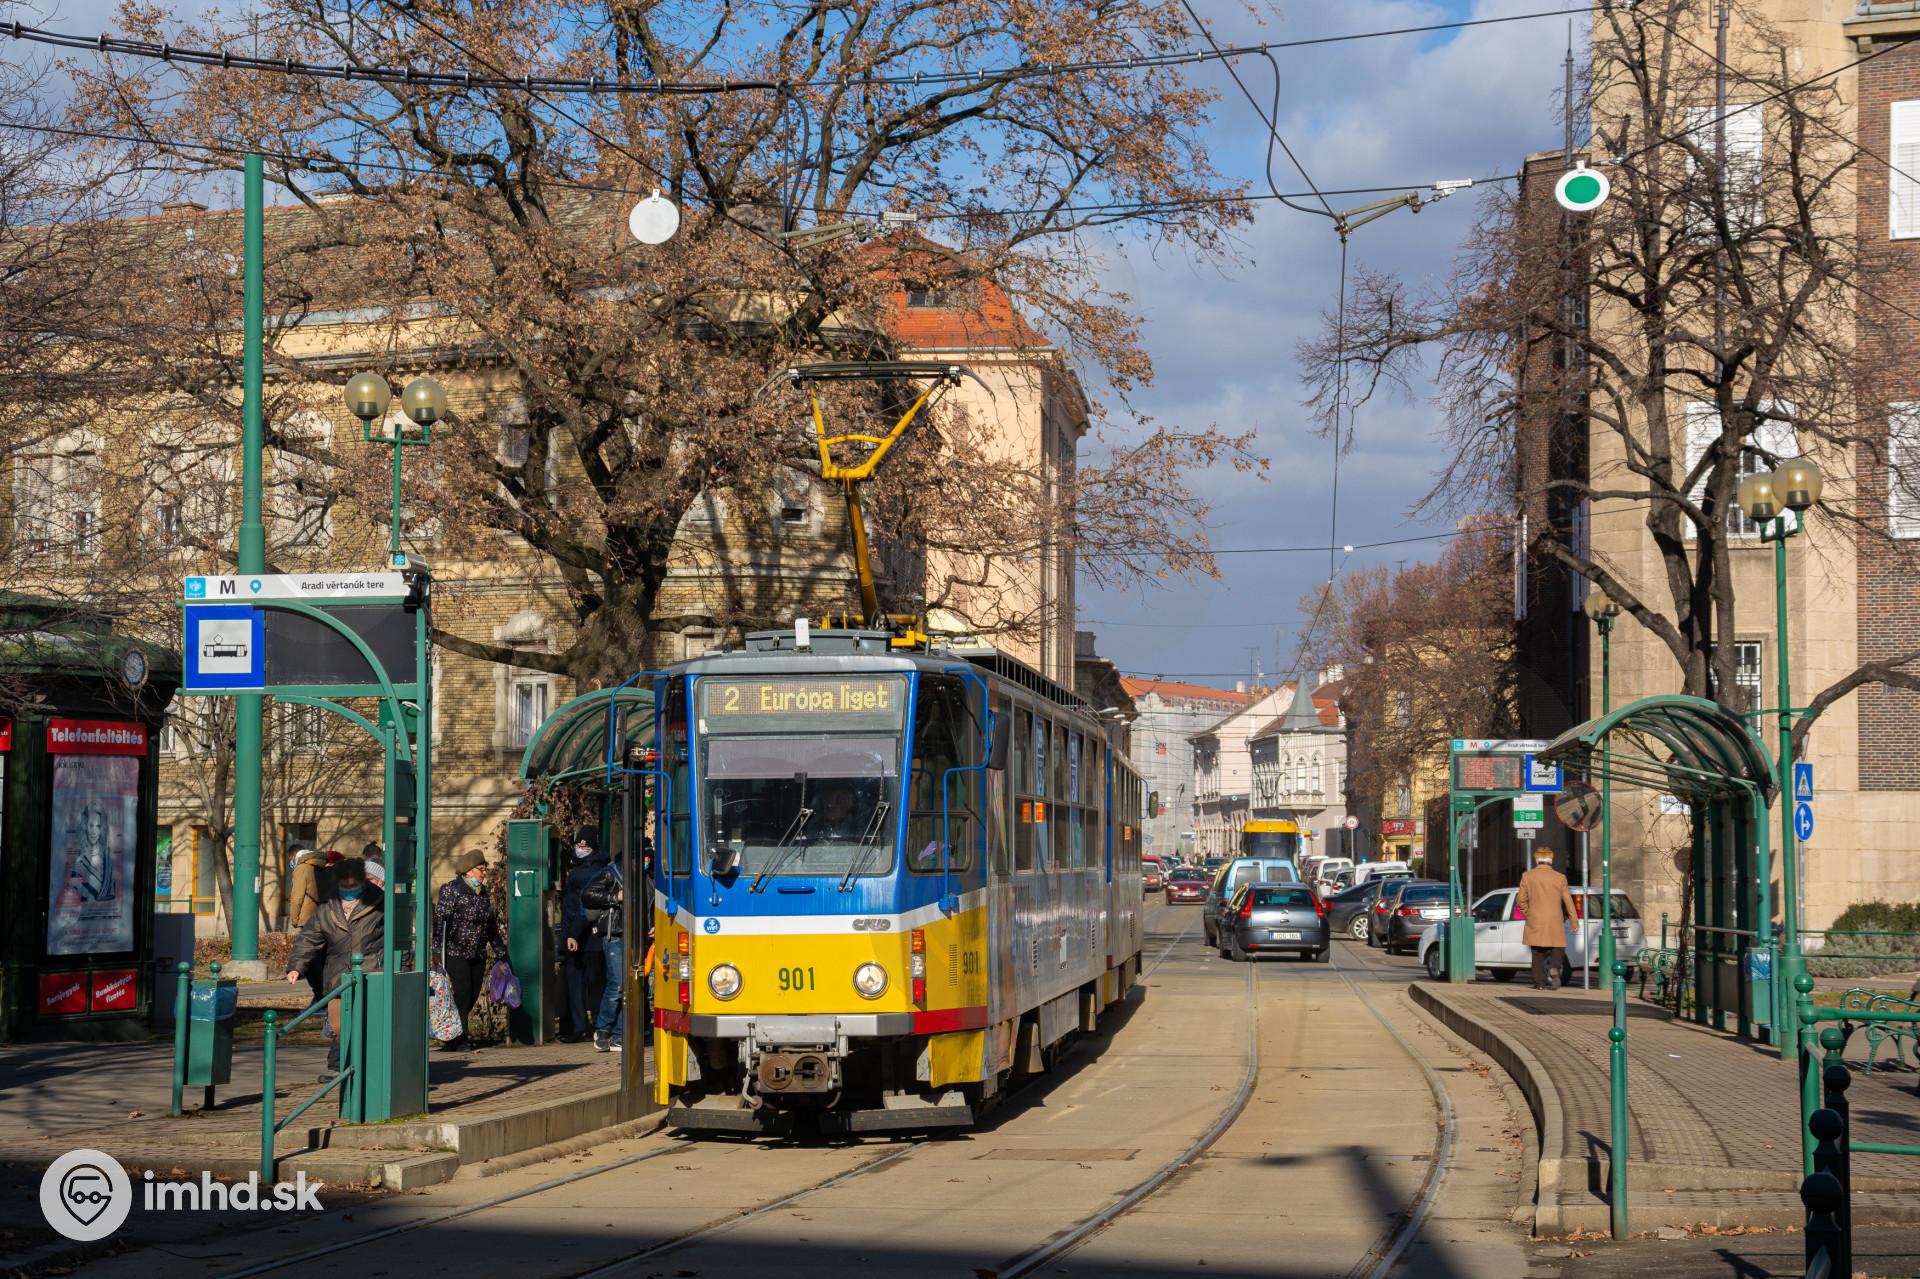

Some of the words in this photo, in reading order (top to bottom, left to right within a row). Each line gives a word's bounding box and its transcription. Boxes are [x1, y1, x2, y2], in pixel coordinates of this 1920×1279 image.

[220, 580, 235, 594] M
[302, 581, 324, 590] Aradi
[326, 580, 364, 590] vértanúk
[367, 581, 384, 589] tere
[724, 686, 740, 711] 2
[760, 686, 834, 711] Európa
[840, 684, 888, 710] liget
[51, 727, 143, 745] Telefonfeltöltés
[963, 951, 979, 975] 901
[778, 967, 816, 991] 901
